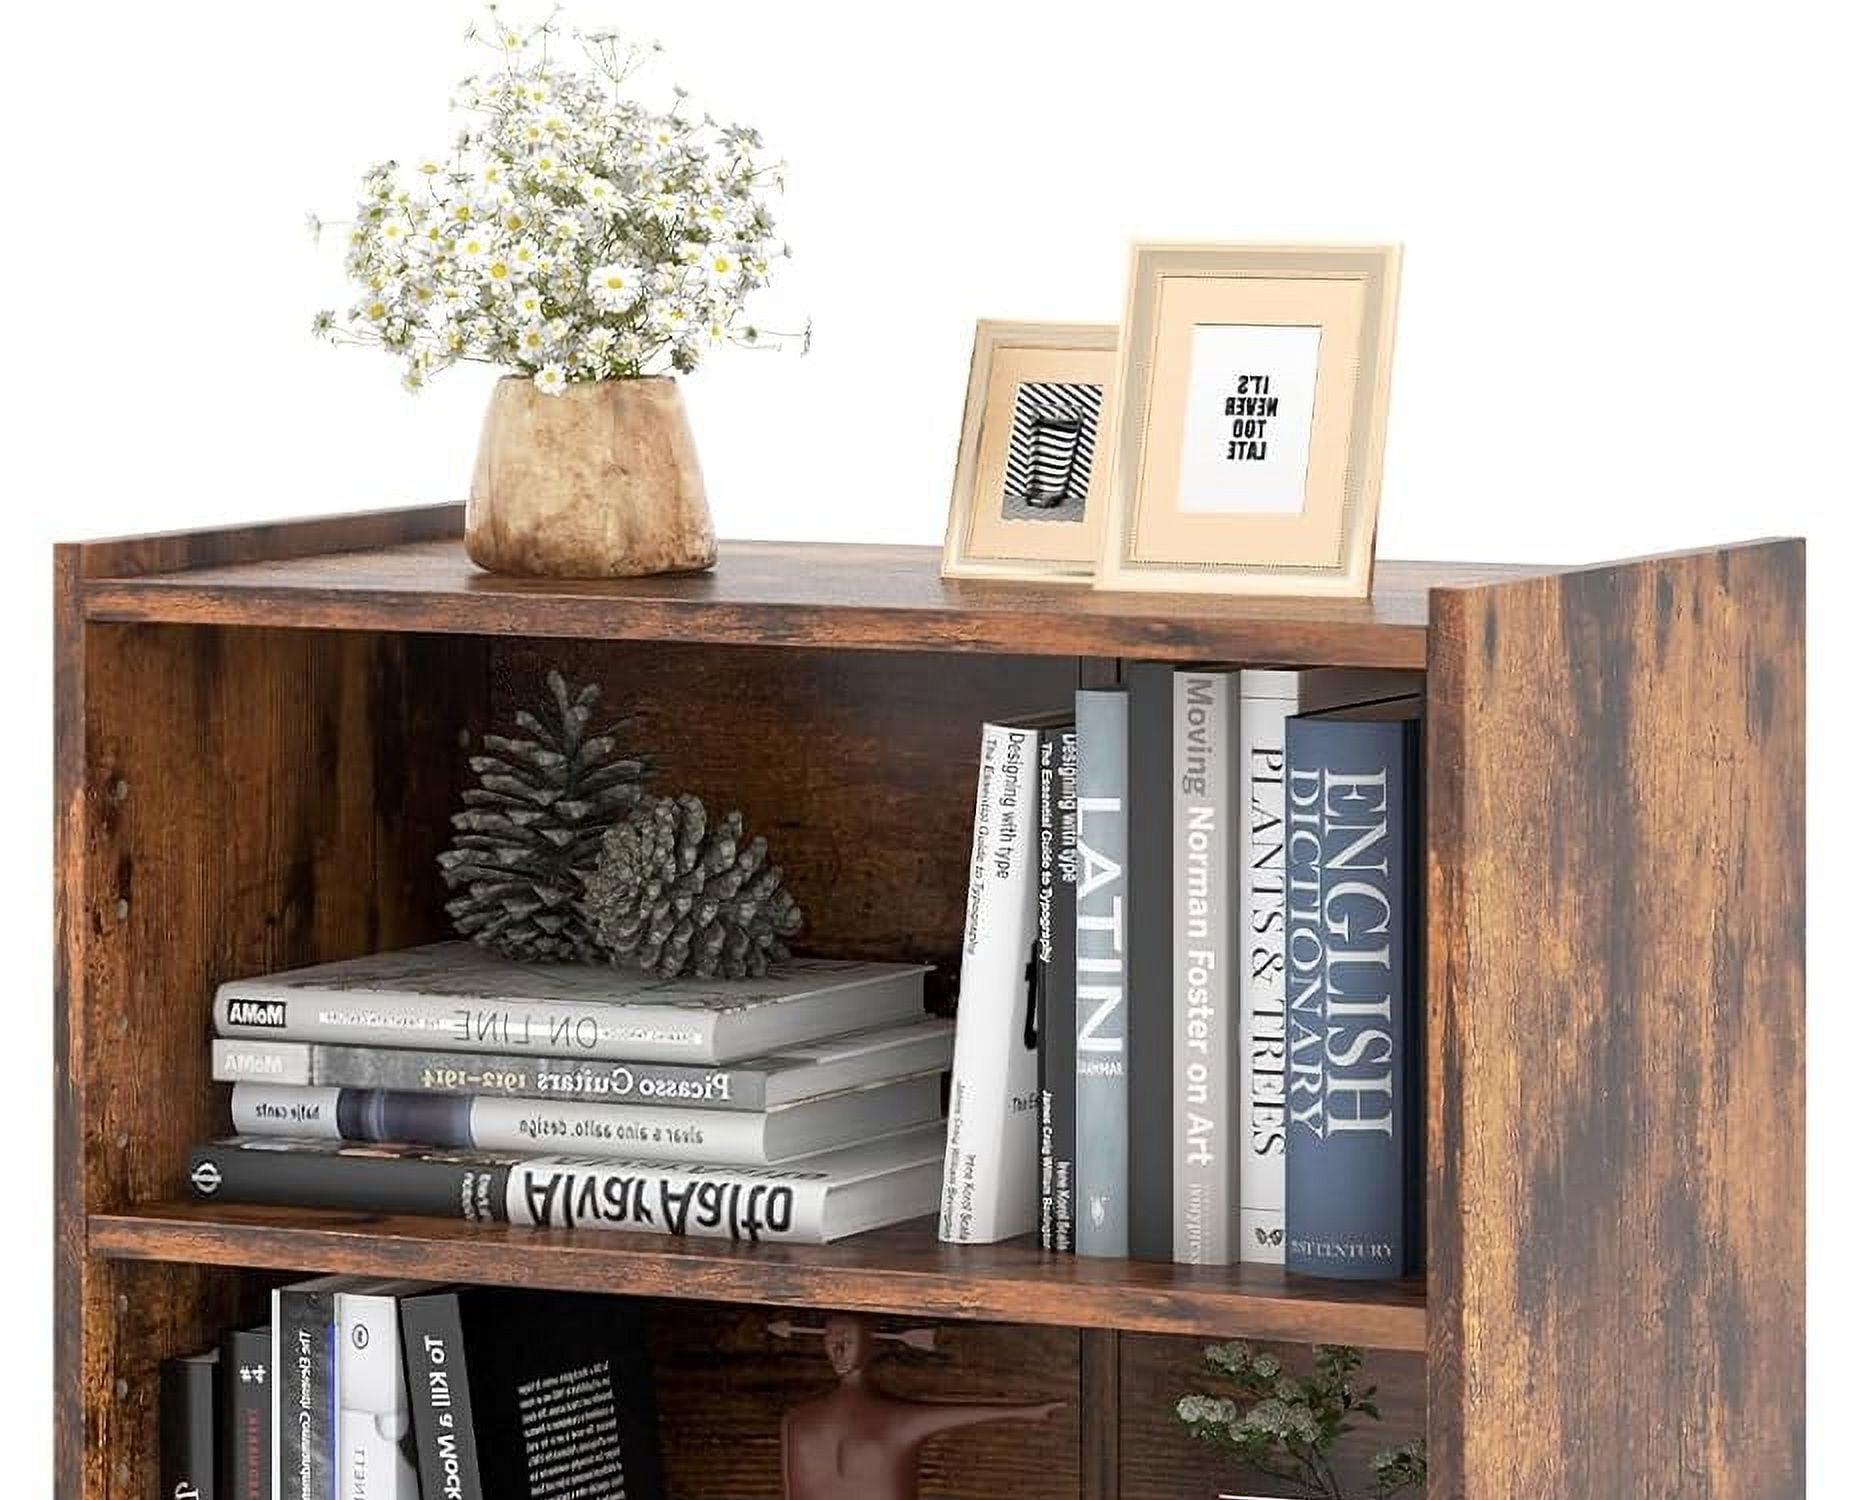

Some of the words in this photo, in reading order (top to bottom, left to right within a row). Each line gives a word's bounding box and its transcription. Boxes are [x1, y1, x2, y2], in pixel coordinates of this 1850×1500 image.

[1000, 733, 1025, 807] Designing
[1041, 742, 1052, 765] The
[1058, 733, 1078, 810] Designing
[1183, 679, 1213, 798] Moving
[996, 845, 1017, 880] type
[1001, 811, 1018, 843] with
[1251, 748, 1284, 934] PLANTS
[1041, 870, 1052, 886] to
[1187, 806, 1215, 938] Norman
[1039, 887, 1053, 963] Typography
[1077, 797, 1122, 1052] LATIN
[1290, 768, 1323, 1140] DICTIONARY
[1325, 767, 1393, 1138] ENGLISH
[1187, 951, 1215, 1053] Foster
[1251, 947, 1284, 985] &
[1187, 1063, 1209, 1105] on
[1252, 998, 1286, 1156] TREES
[1186, 1112, 1215, 1167] Art
